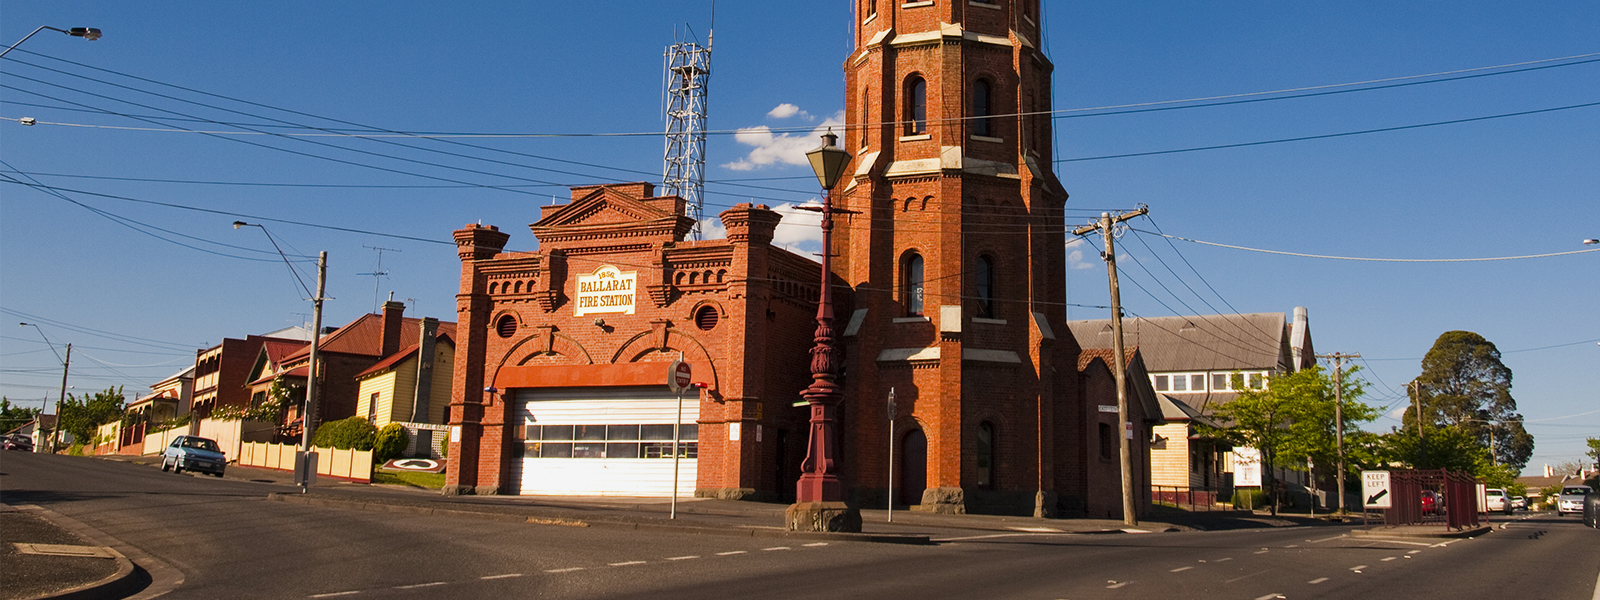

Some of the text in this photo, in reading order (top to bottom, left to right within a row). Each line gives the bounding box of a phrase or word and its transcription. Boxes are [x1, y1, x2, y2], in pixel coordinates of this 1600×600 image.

[580, 278, 633, 292] BALLARAT
[579, 293, 633, 308] FIRE STATION
